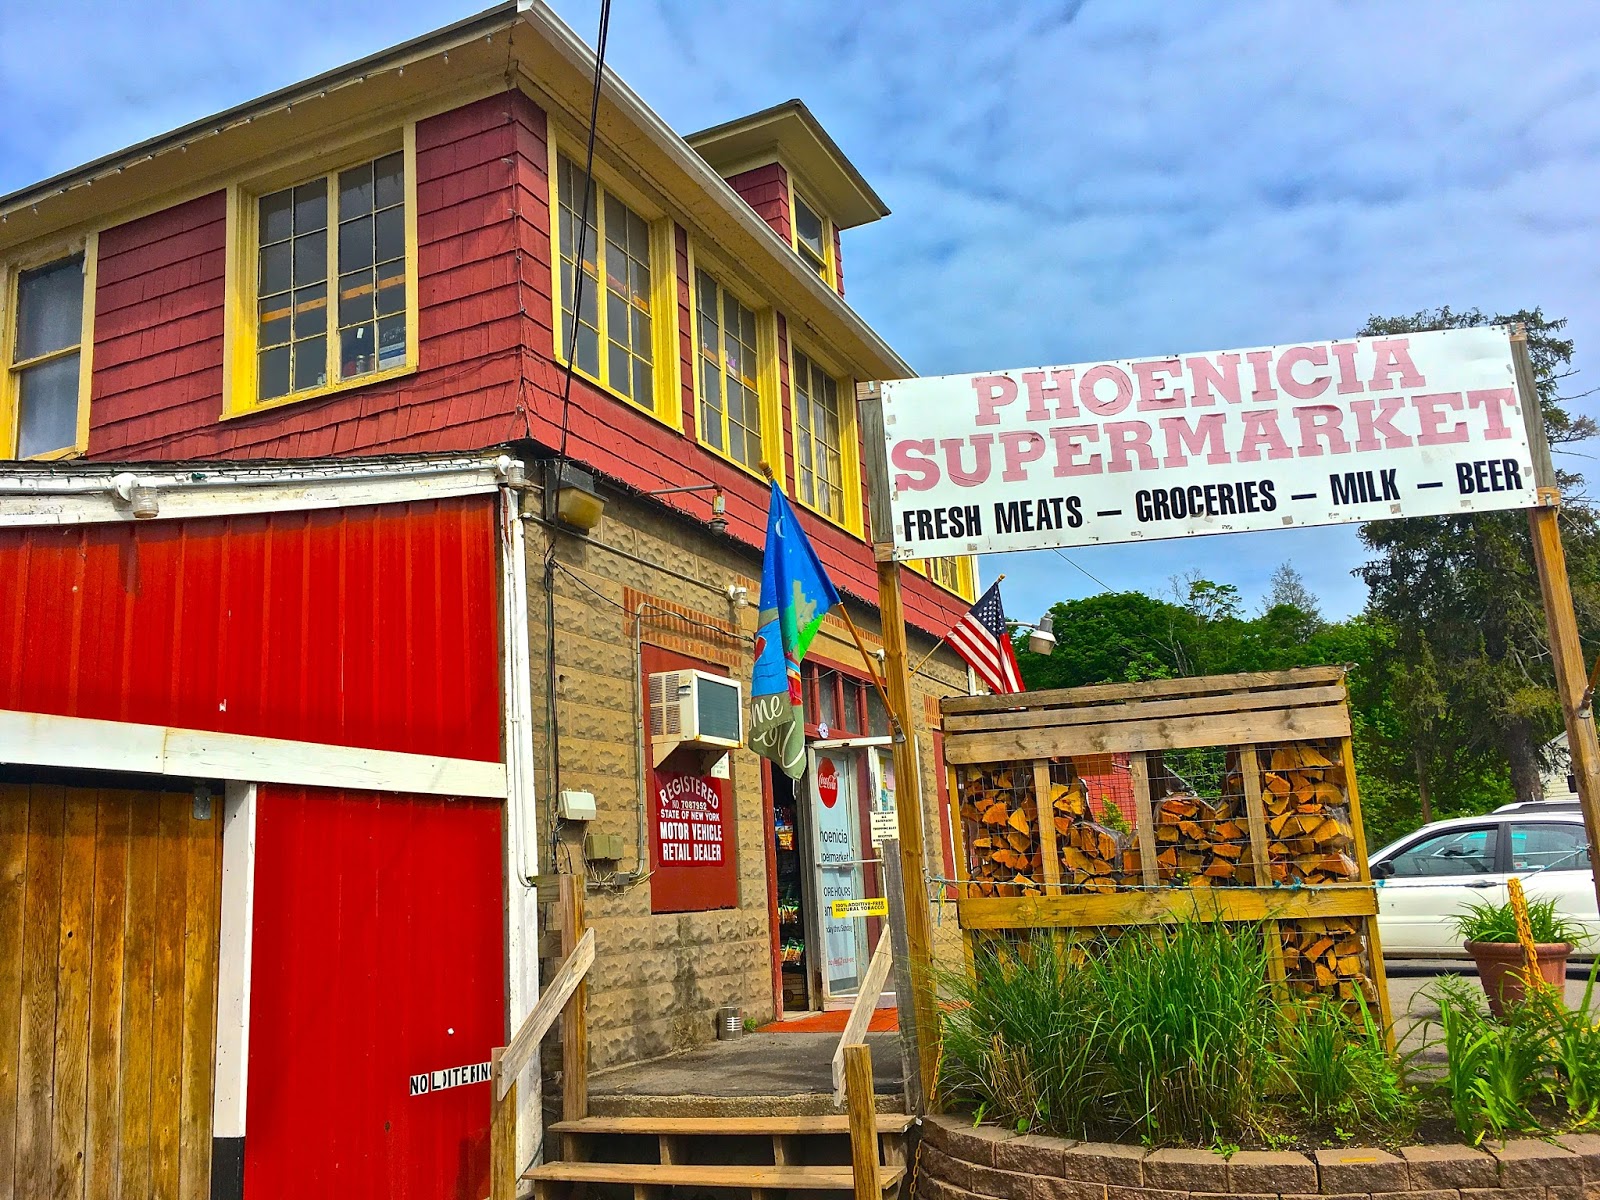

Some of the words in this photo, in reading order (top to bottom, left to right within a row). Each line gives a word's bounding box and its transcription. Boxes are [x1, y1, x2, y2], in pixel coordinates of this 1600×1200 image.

[971, 338, 1426, 426] PHOENICIA
[891, 387, 1516, 492] SUPERMARKET
[902, 505, 982, 542] FRESH
[994, 496, 1083, 535] MEATS
[1135, 479, 1277, 522] GROCERIES
[1329, 468, 1400, 505] MILK
[1456, 458, 1523, 495] BEER
[749, 695, 784, 731] me
[659, 775, 719, 810] REGISTERED
[660, 809, 680, 819] STATE
[681, 811, 690, 820] OF
[691, 811, 704, 821] NEW
[705, 812, 720, 822] YORK
[681, 800, 707, 811] 7087952
[660, 822, 690, 840] MOTOR
[691, 823, 723, 842] VEHICLE
[662, 842, 692, 861] RETAIL
[693, 843, 722, 861] DEALER
[835, 886, 851, 897] HOURS
[410, 1074, 428, 1094] NO
